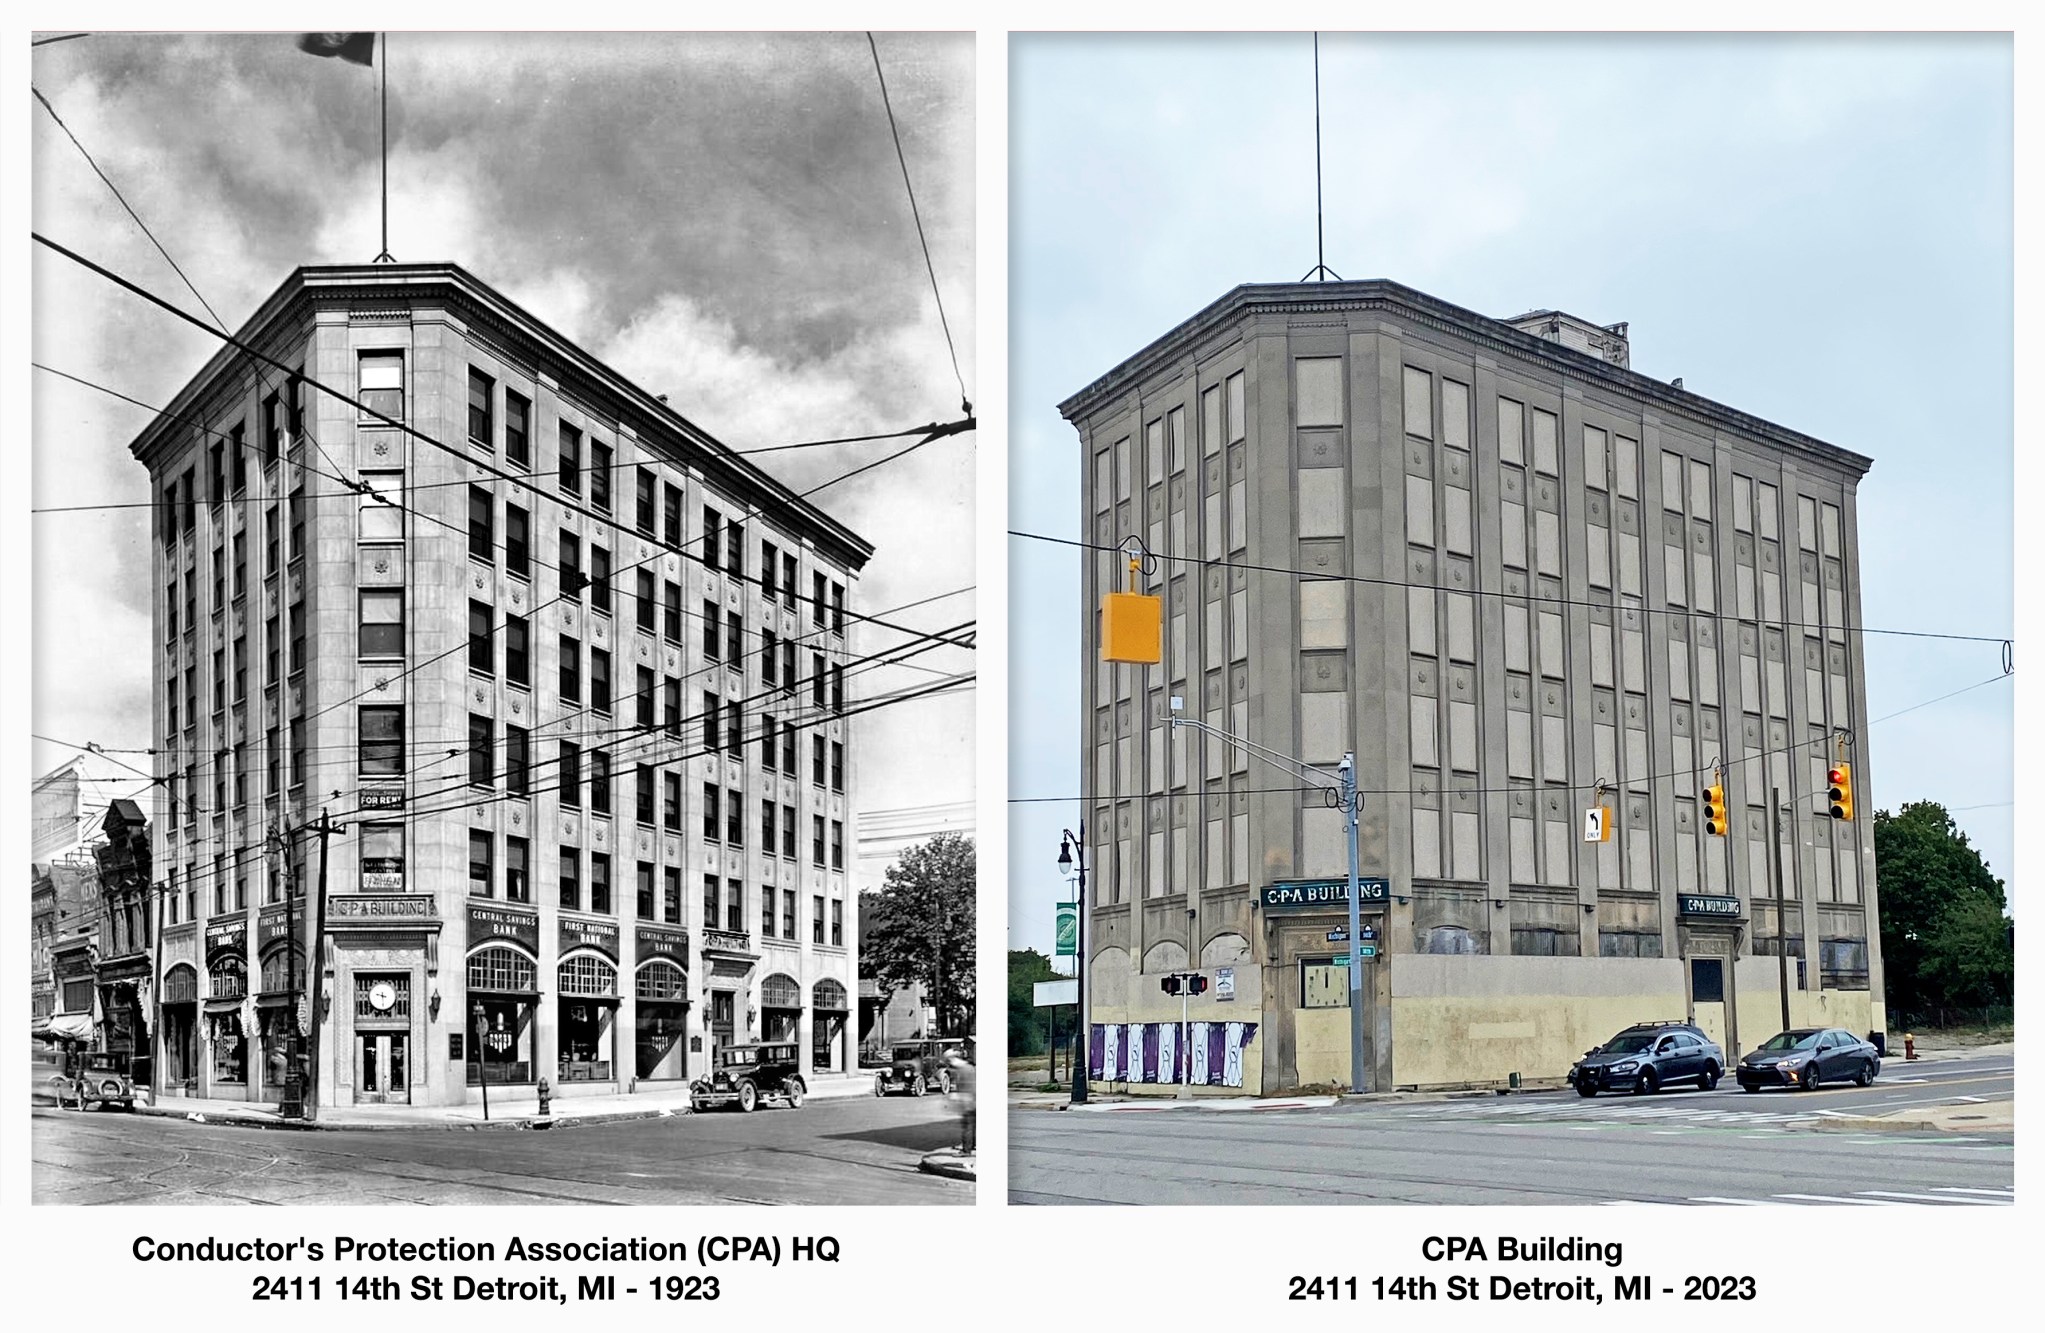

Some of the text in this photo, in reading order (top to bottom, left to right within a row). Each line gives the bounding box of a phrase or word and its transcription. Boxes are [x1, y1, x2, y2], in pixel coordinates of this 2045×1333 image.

[361, 796, 402, 805] FOR RENT
[1307, 884, 1382, 901] BUILDNG
[371, 902, 424, 915] BUILDING
[1706, 900, 1739, 914] BUILDING
[472, 910, 536, 926] CENTRAL SAVINGS
[493, 925, 518, 936] BANK
[564, 921, 616, 935] FIRST NATIONAL
[580, 933, 601, 944] BANK
[640, 931, 687, 944] CENTRAL SAVINGS
[654, 943, 673, 952] BANK
